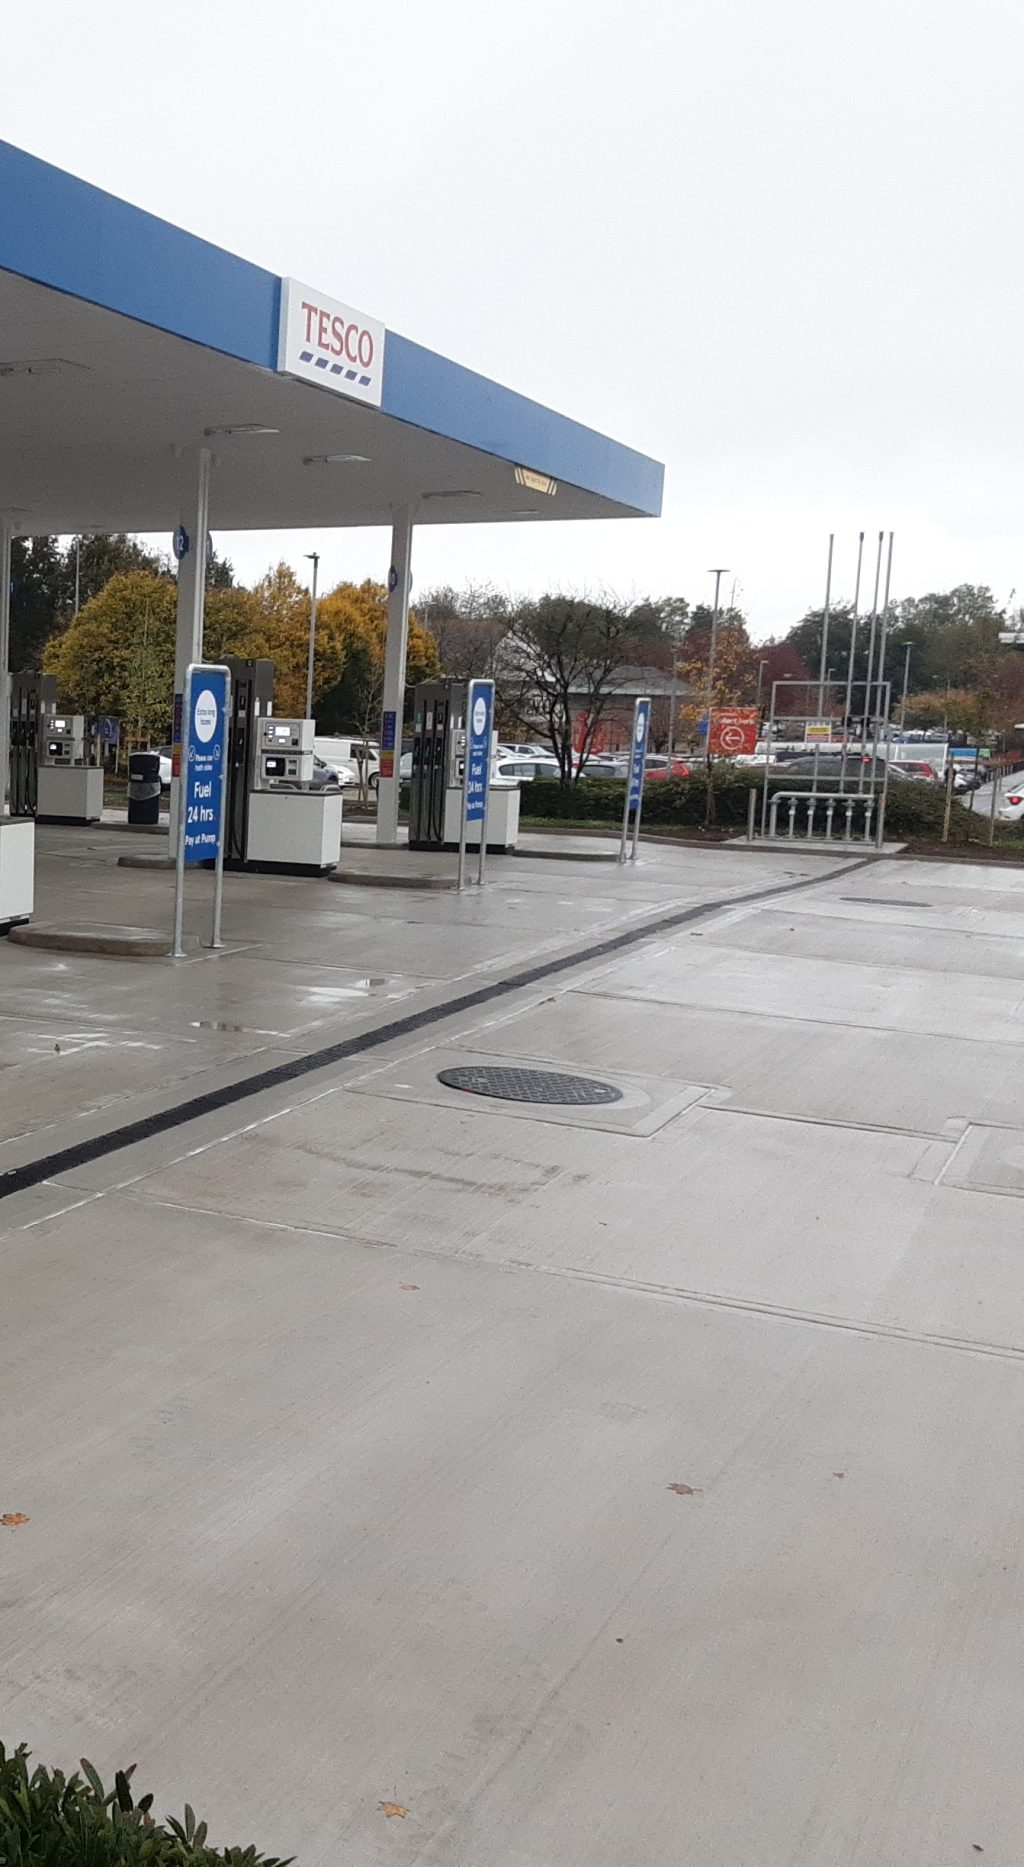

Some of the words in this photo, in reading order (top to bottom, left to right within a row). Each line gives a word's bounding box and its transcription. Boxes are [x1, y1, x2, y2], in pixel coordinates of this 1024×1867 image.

[301, 301, 374, 368] TESCO
[176, 535, 184, 551] 12
[193, 780, 212, 798] Fuel
[187, 806, 198, 823] 24
[200, 805, 214, 822] hrs
[185, 835, 195, 847] Pay
[201, 833, 216, 845] Pump
